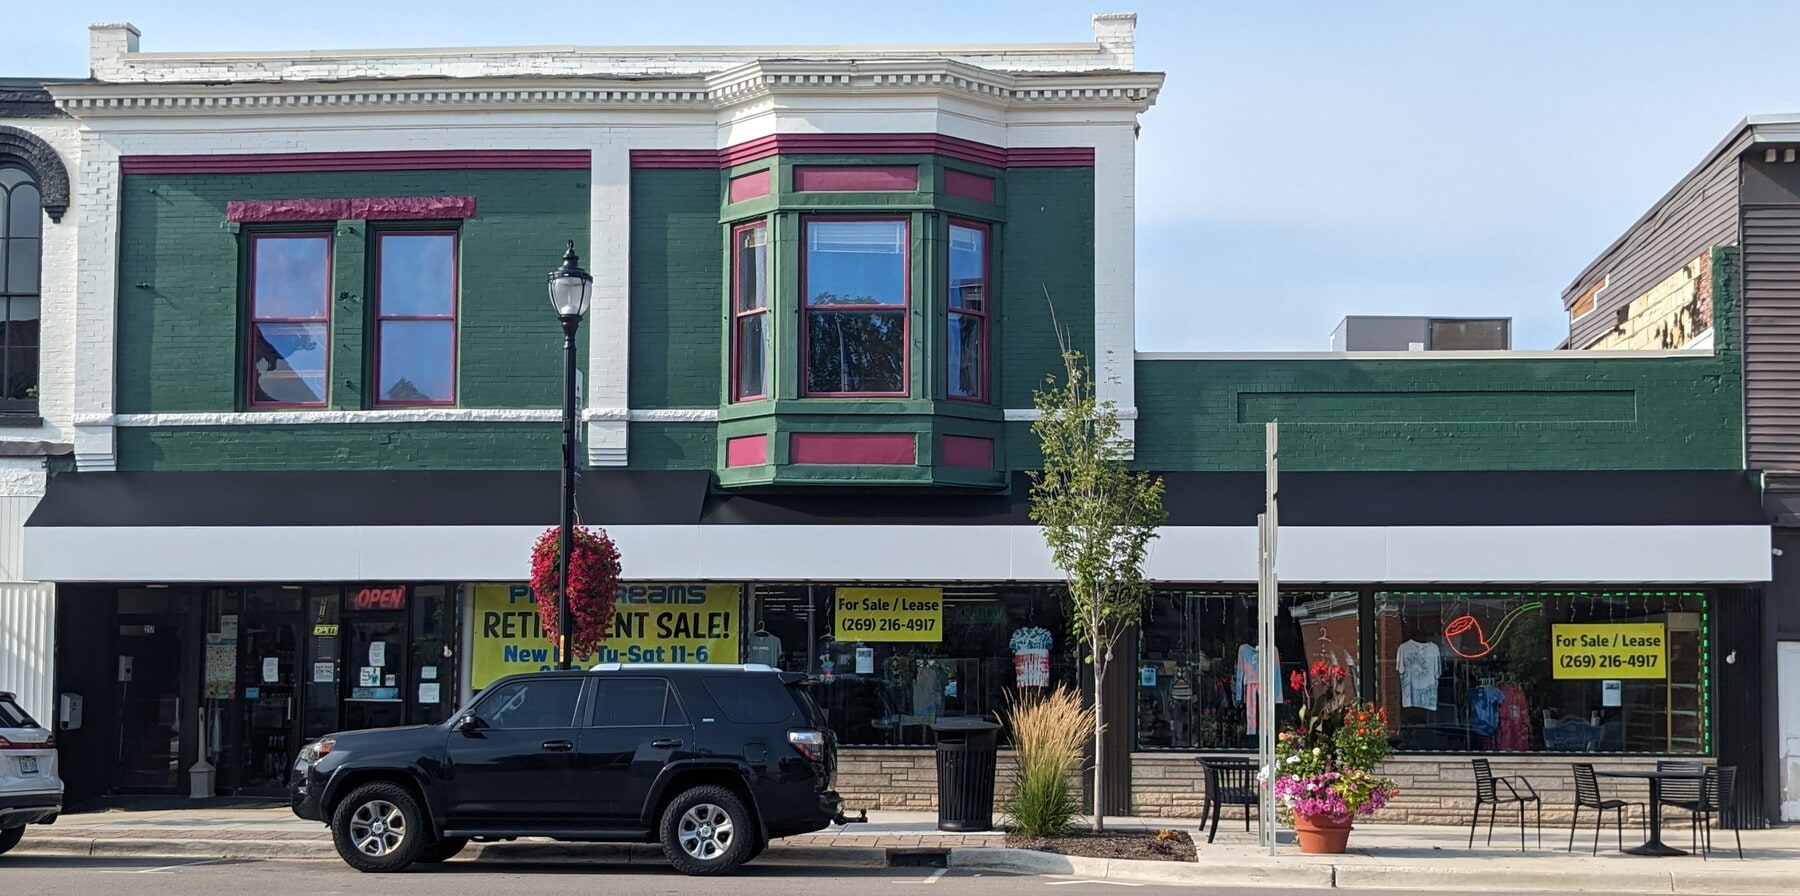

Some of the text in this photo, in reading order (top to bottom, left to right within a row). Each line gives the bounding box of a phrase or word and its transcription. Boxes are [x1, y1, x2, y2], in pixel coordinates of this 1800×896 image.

[357, 587, 404, 608] OPEN
[839, 597, 939, 612] For Sale / Lease
[315, 626, 337, 635] OPEN
[656, 611, 731, 639] SALE!
[842, 618, 936, 632] (269) 216-4917
[1556, 633, 1661, 648] For Sale / Lease
[504, 645, 548, 662] New
[598, 645, 665, 663] Tu-Sat
[670, 645, 709, 663] 11-6
[1560, 654, 1658, 668] (269) 216-4917
